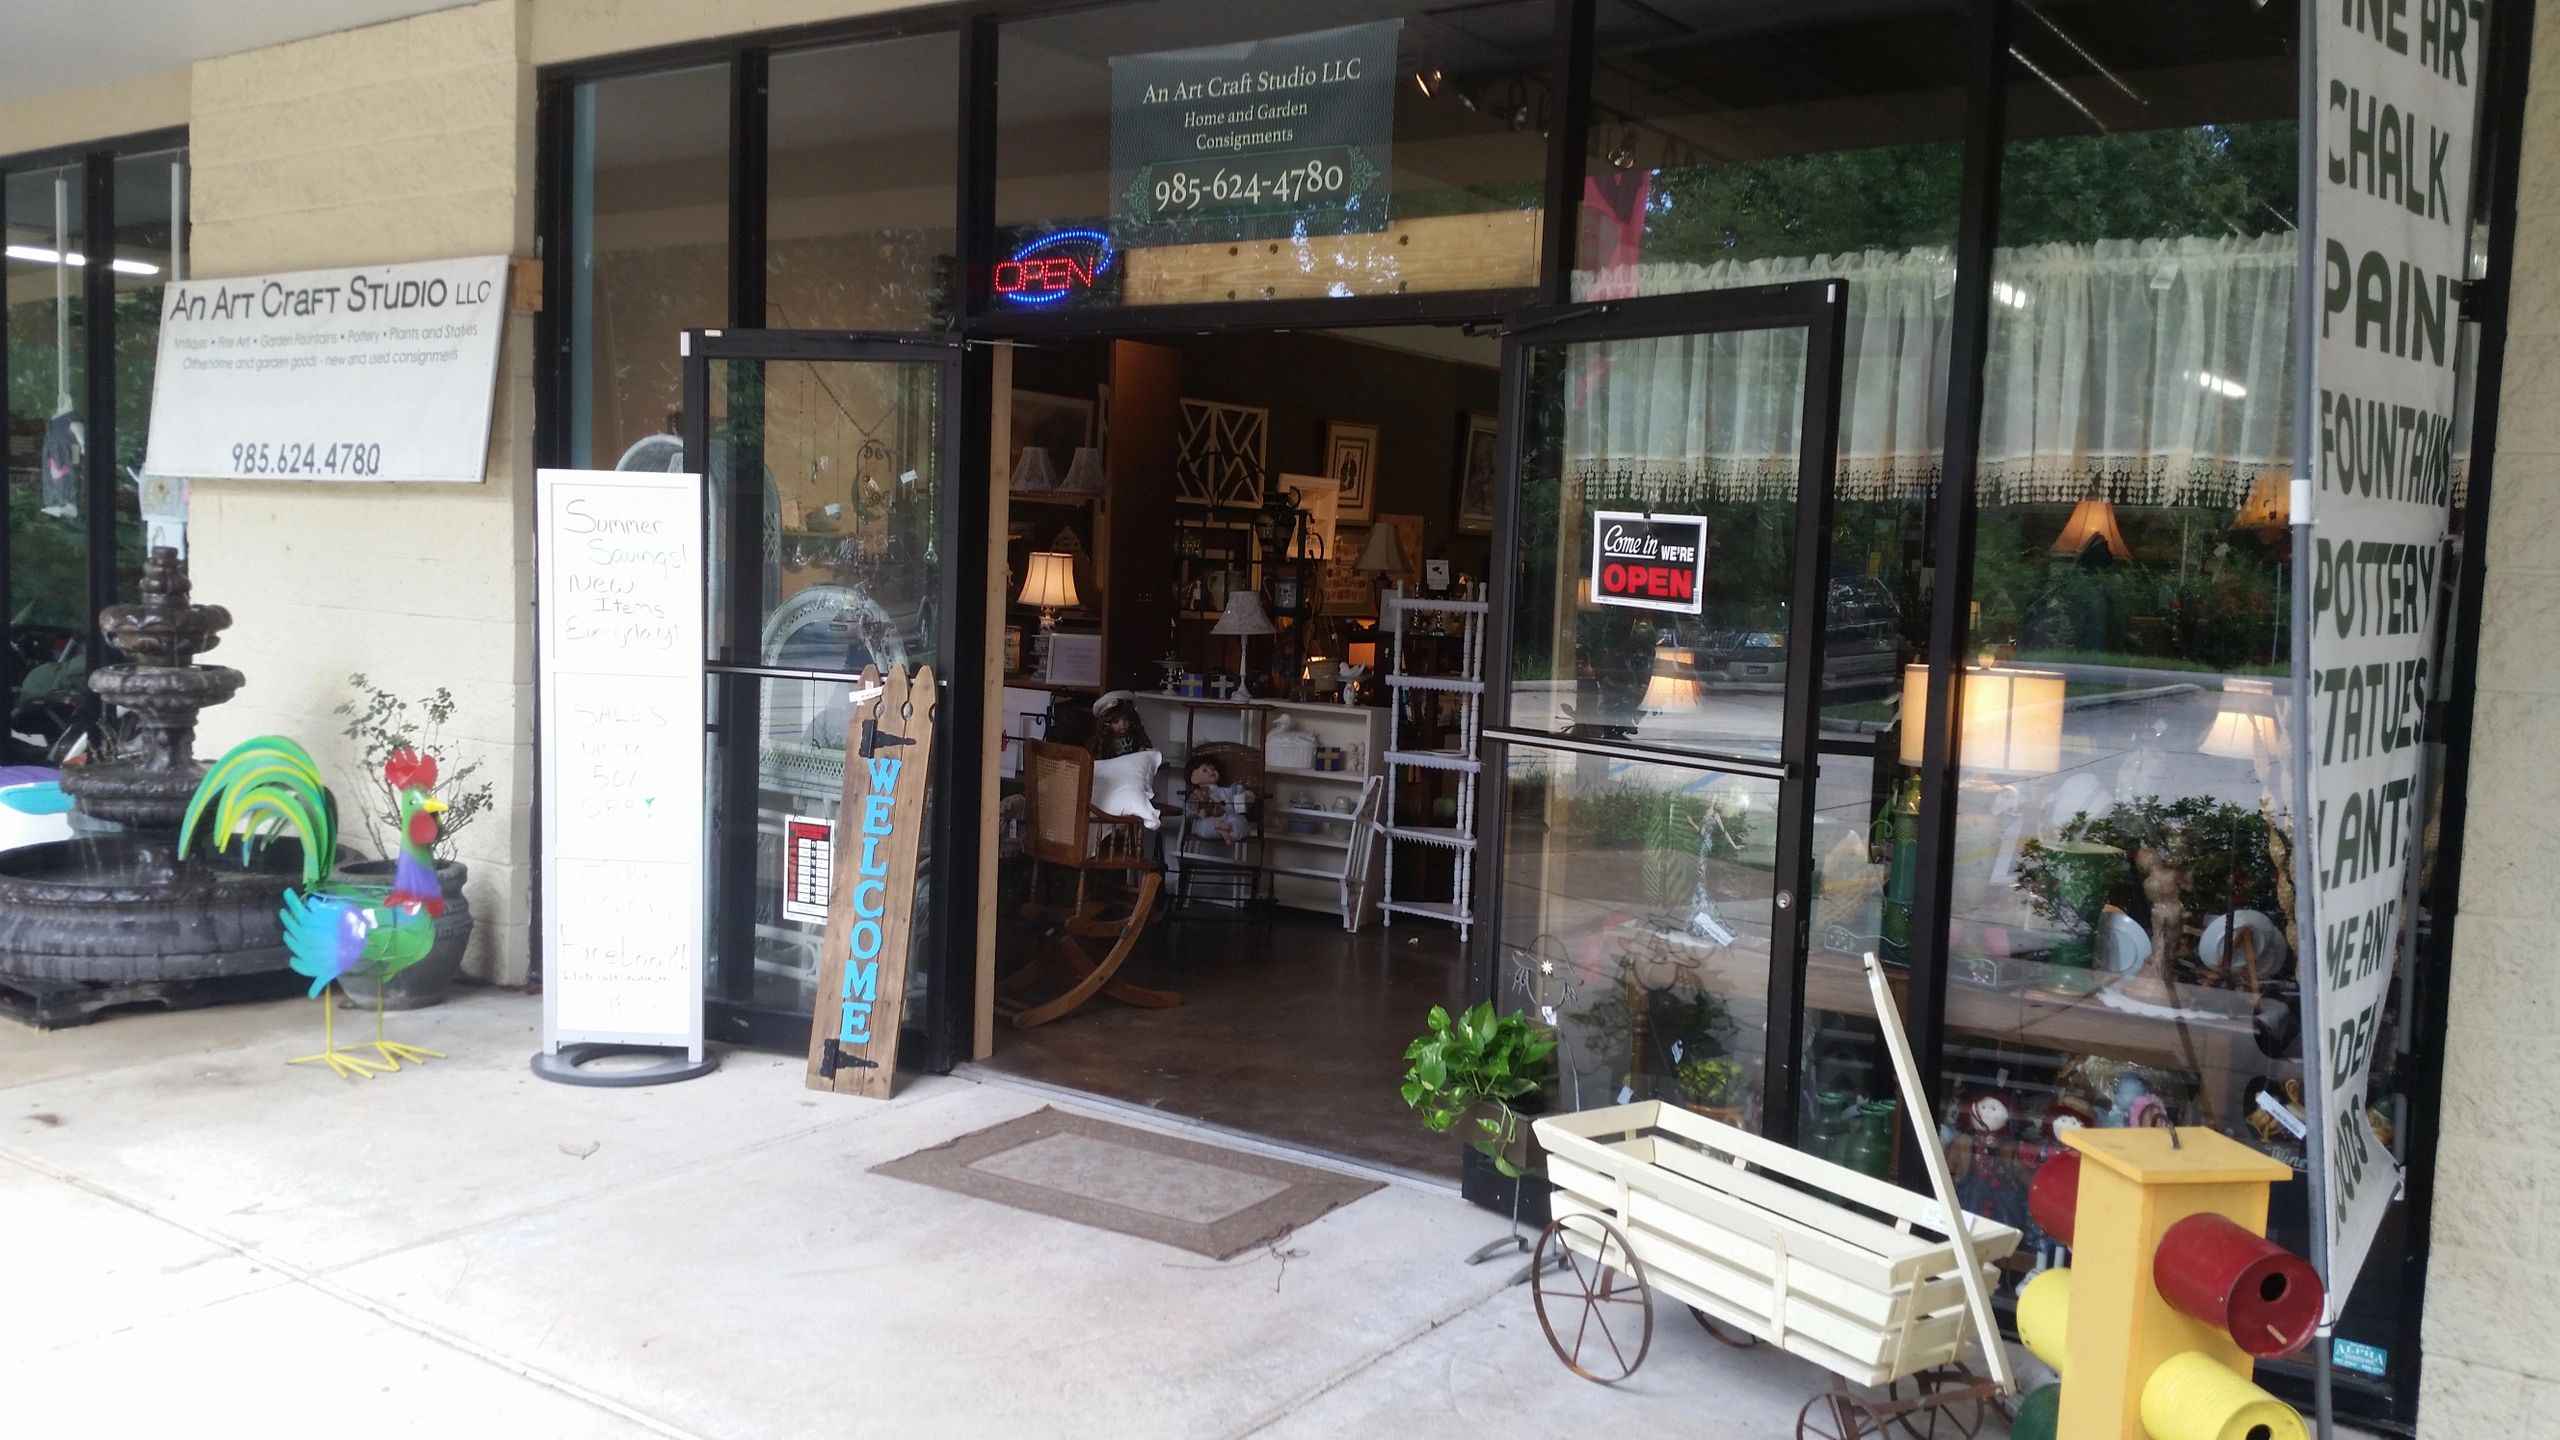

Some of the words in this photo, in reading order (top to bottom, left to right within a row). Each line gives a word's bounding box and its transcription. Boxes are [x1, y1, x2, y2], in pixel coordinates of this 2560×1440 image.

[1142, 84, 1169, 104] An
[1174, 79, 1204, 101] Art
[1208, 72, 1253, 98] Craft
[1257, 65, 1317, 91] Studio
[1322, 57, 1362, 83] LLC
[1184, 110, 1225, 128] Home
[1228, 107, 1254, 124] and
[1257, 102, 1308, 120] Garden
[1196, 127, 1294, 151] Consignments
[2328, 79, 2450, 225] CHALK
[1155, 159, 1343, 212] 985-624-4780
[993, 256, 1094, 293] OPEN
[169, 287, 206, 322] An
[455, 279, 492, 306] LLC
[236, 335, 251, 348] Art
[260, 333, 293, 348] Garden
[295, 331, 337, 346] Fountains
[347, 329, 380, 345] Pottery
[390, 326, 420, 341] Plants
[422, 325, 443, 340] and
[235, 357, 254, 370] and
[256, 356, 289, 372] garden
[290, 355, 318, 371] goods
[325, 354, 346, 367] new
[347, 352, 367, 366] and
[369, 351, 390, 365] used
[232, 441, 381, 476] 985.624.4780
[564, 499, 664, 535] Summer
[1604, 524, 1641, 554] Come
[1643, 534, 1659, 555] in
[1661, 545, 1695, 562] WE'RE
[569, 574, 634, 594] New
[1603, 563, 1693, 599] OPEN
[2313, 538, 2436, 640] POTTERY
[593, 597, 665, 619] Items
[840, 757, 904, 1044] WELCOME
